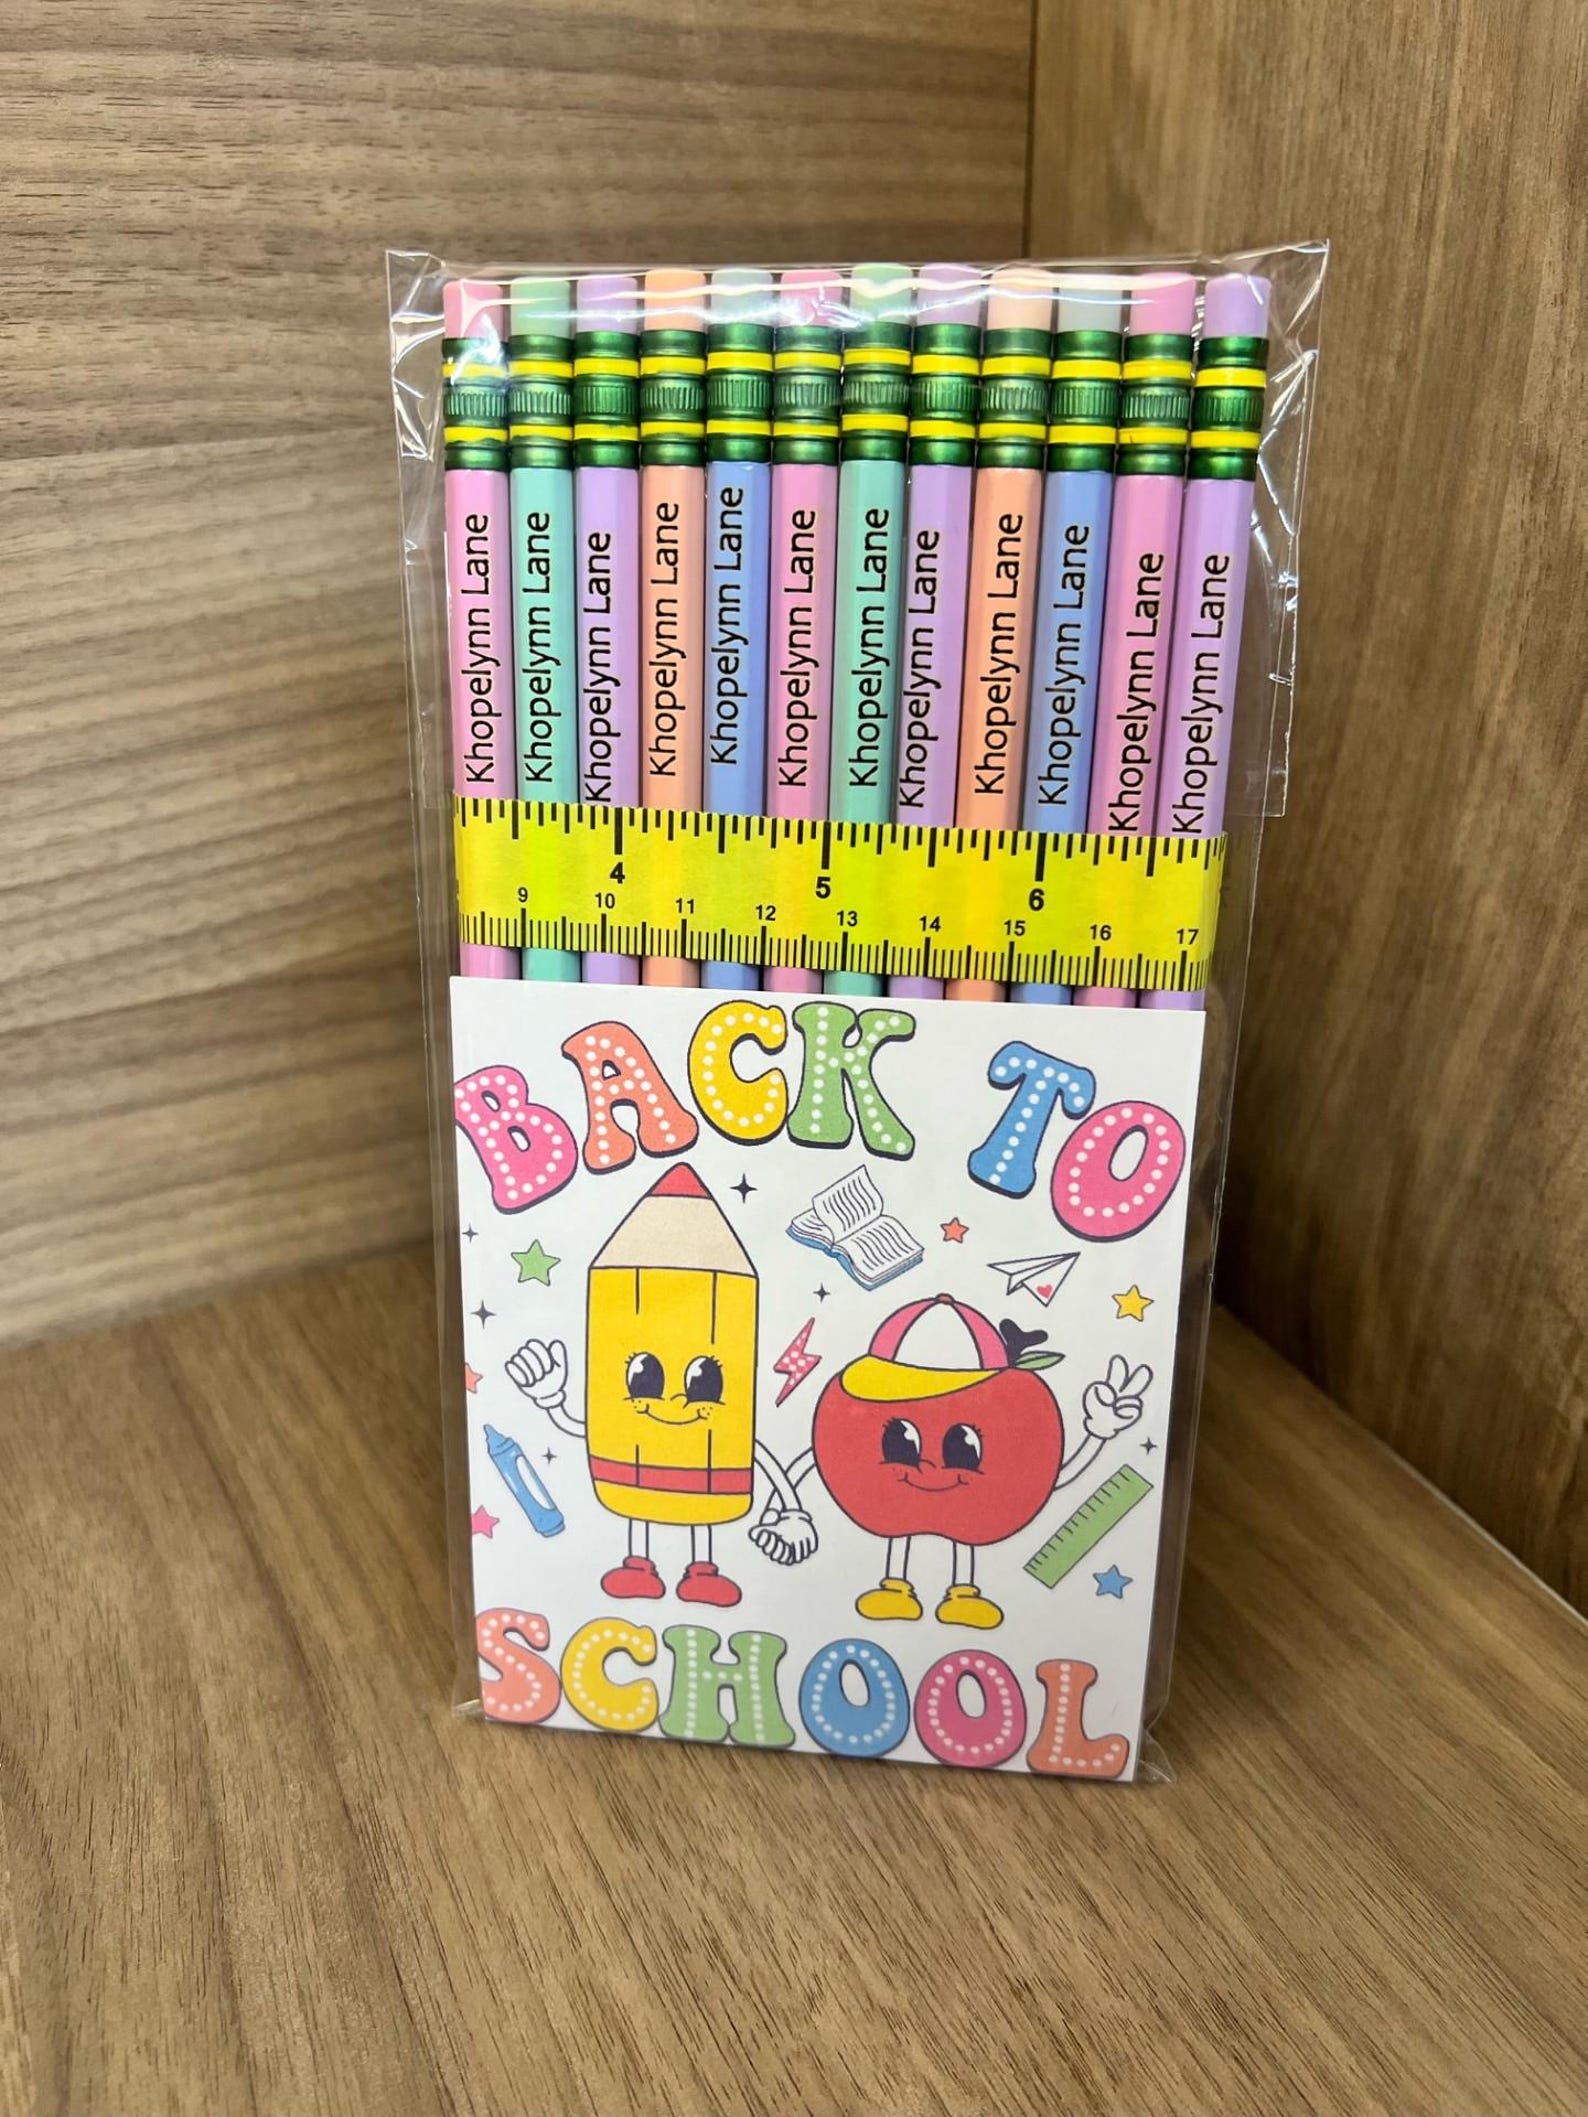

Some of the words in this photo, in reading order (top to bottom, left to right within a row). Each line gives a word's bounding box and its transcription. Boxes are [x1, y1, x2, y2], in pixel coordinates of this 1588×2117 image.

[461, 514, 489, 595] Lane
[522, 511, 550, 593] Lane
[584, 531, 611, 613] Lane
[651, 502, 679, 585] Lane
[714, 486, 742, 570] Lane
[785, 509, 815, 593] Lane
[857, 508, 889, 592] Lane
[909, 530, 939, 614] Lane
[988, 513, 1022, 599] Lane
[1054, 525, 1089, 609] Lane
[1127, 553, 1164, 637] Lane
[1191, 555, 1229, 638] Lane
[461, 607, 501, 782] Khopelynn
[522, 606, 561, 782] Khopelynn
[584, 626, 621, 802] Khopelynn
[649, 598, 686, 776] Khopelynn
[710, 584, 748, 764] Khopelynn
[778, 607, 819, 786] Khopelynn
[849, 606, 890, 786] Khopelynn
[899, 627, 942, 807] Khopelynn
[974, 613, 1020, 793] Khopelynn
[1038, 624, 1085, 804] Khopelynn
[1108, 651, 1157, 830] Khopelynn
[1172, 653, 1223, 833] Khopelynn
[518, 888, 528, 903] 9
[595, 893, 615, 908] 10
[676, 899, 694, 914] 11
[755, 905, 776, 921] 12
[837, 911, 858, 926] 13
[920, 916, 941, 932] 14
[1004, 920, 1025, 936] 15
[1090, 925, 1111, 940] 16
[1177, 929, 1199, 944] 17
[610, 862, 625, 884] 4
[815, 876, 831, 898] 5
[1029, 889, 1044, 911] 6
[454, 1000, 916, 1214] BACK
[968, 1041, 1186, 1242] TO
[476, 1608, 1129, 1779] SCHOOL
